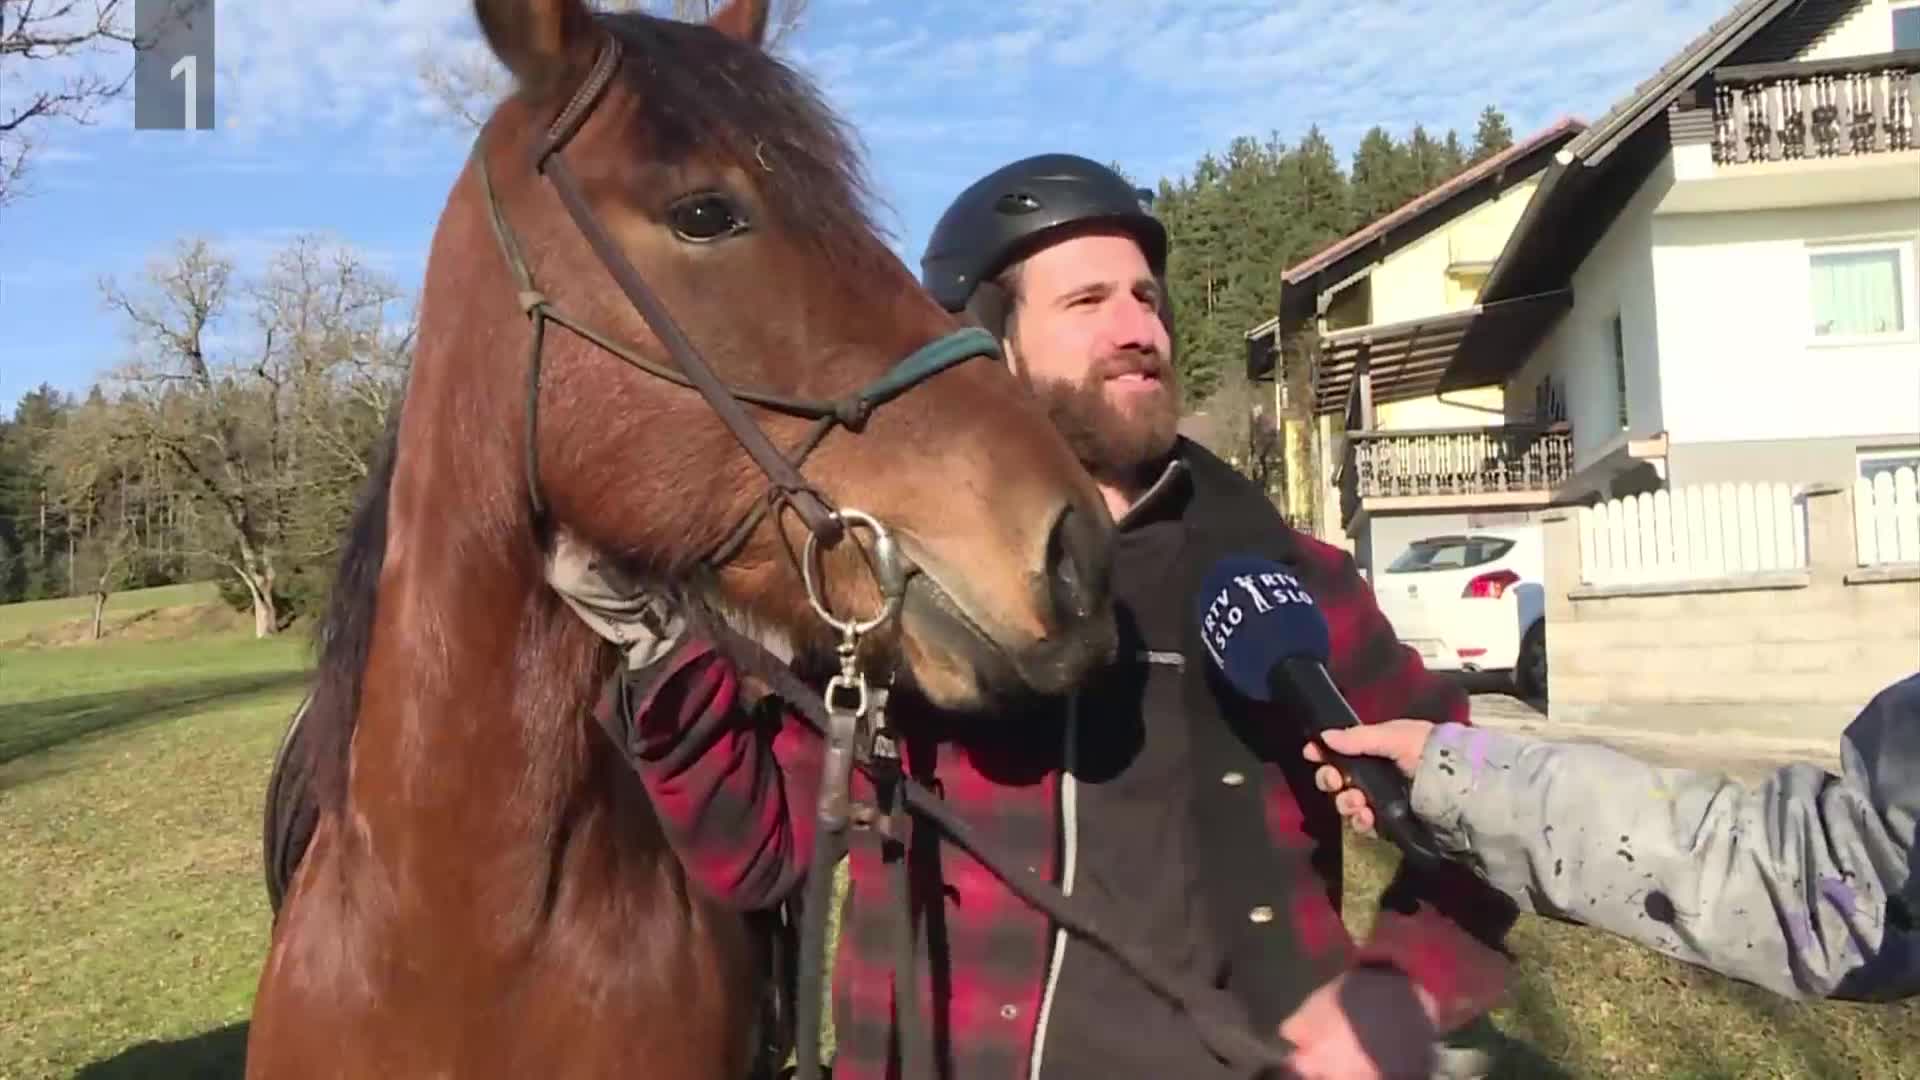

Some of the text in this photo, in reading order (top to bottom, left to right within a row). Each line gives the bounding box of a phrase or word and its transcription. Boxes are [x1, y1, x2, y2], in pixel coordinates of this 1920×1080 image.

[1260, 573, 1299, 588] RTV
[1204, 588, 1229, 633] RTV
[1273, 588, 1314, 606] SLO
[1215, 605, 1243, 650] SLO
